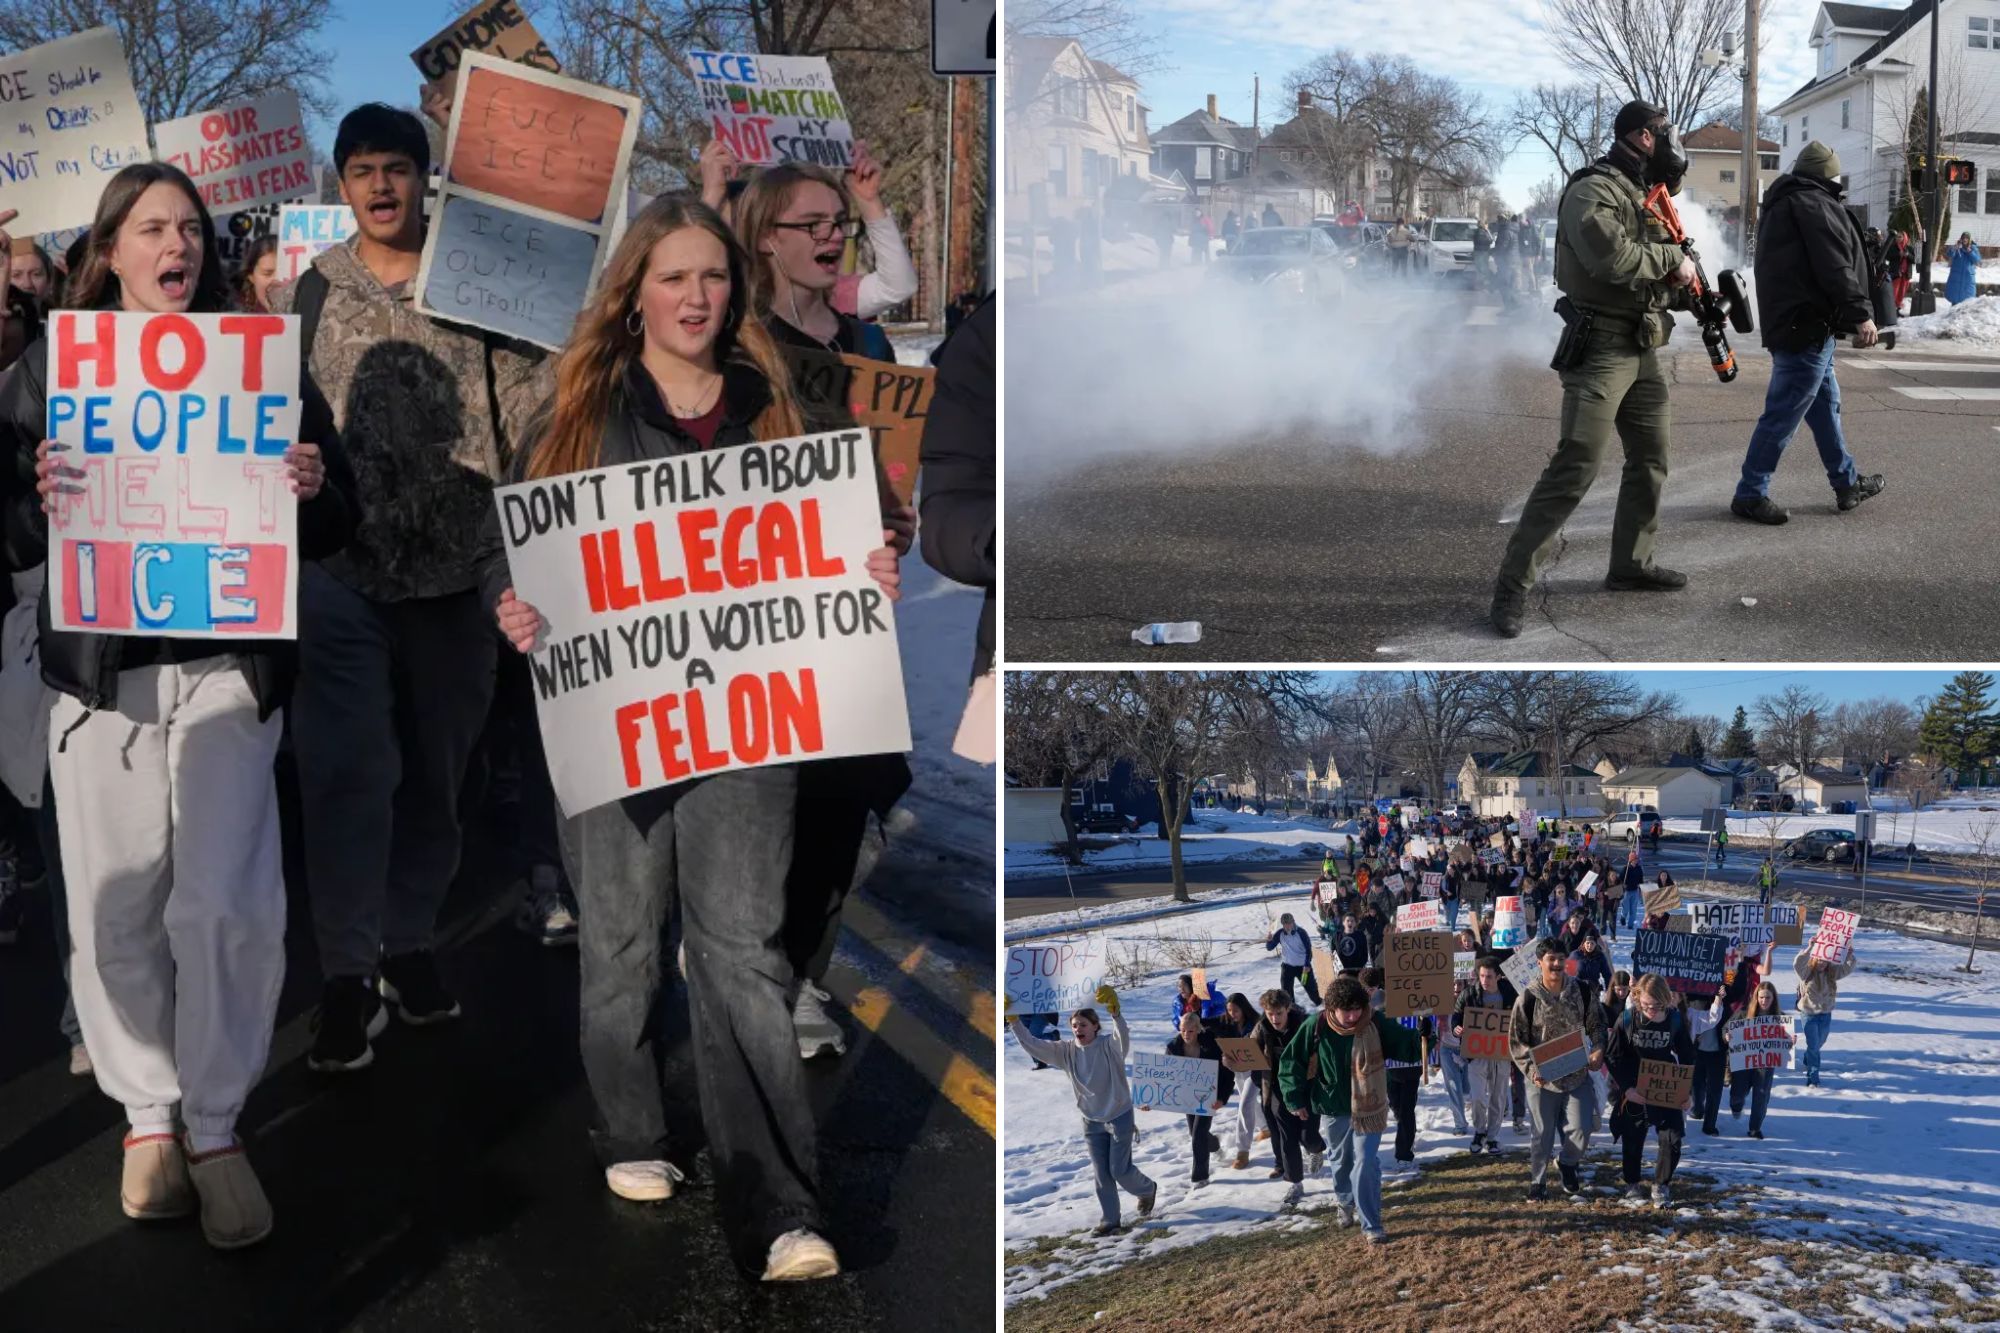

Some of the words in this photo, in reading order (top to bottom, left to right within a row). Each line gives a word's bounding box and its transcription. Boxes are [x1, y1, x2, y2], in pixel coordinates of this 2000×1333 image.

[689, 52, 757, 83] ICE
[0, 70, 36, 102] CE
[702, 82, 723, 97] IN
[748, 87, 849, 121] MATCHA
[201, 106, 259, 142] OUR
[713, 115, 775, 163] NOT
[798, 120, 830, 136] MY
[224, 175, 256, 204] IN
[257, 160, 310, 196] FEAR
[283, 209, 356, 241] MEL
[469, 213, 546, 252] ICE
[57, 312, 286, 392] HOT
[871, 370, 928, 419] PPL
[48, 390, 291, 456] PEOPLE
[49, 455, 293, 539] MELT
[502, 474, 606, 548] DON'T
[627, 452, 726, 511] TALK
[740, 433, 862, 493] ABOUT
[579, 498, 847, 614] ILLEGAL
[76, 542, 258, 628] ICE
[528, 628, 614, 701] WHEN
[617, 610, 691, 670] YOU
[700, 597, 803, 652] VOTED
[816, 587, 888, 640] FOR
[685, 658, 715, 688] A
[615, 668, 824, 789] FELON
[1694, 904, 1740, 925] HATE
[1770, 907, 1797, 924] OUR
[1820, 919, 1854, 937] PEOPLE
[1823, 908, 1856, 925] HOT
[1392, 936, 1441, 952] RENEE
[1492, 927, 1522, 947] ICE
[1639, 931, 1662, 954] YOU
[1692, 935, 1721, 962] GET
[1742, 926, 1774, 943] OOLS
[1817, 931, 1852, 947] MELT
[1009, 945, 1074, 977] STOP
[1398, 952, 1448, 972] GOOD
[1811, 941, 1848, 963] ICE
[1392, 979, 1423, 990] ICE
[1638, 964, 1667, 977] WHEN
[1668, 966, 1676, 977] U
[1679, 968, 1705, 981] VOTED
[1706, 972, 1723, 983] FOR
[1407, 993, 1440, 1009] BAD
[1467, 1010, 1511, 1033] ICE
[1743, 1024, 1789, 1041] ILLEGAL
[1467, 1033, 1510, 1057] OUT
[1745, 1051, 1782, 1069] FELON
[1645, 1089, 1677, 1104] ICE
[1649, 1077, 1681, 1090] MELT
